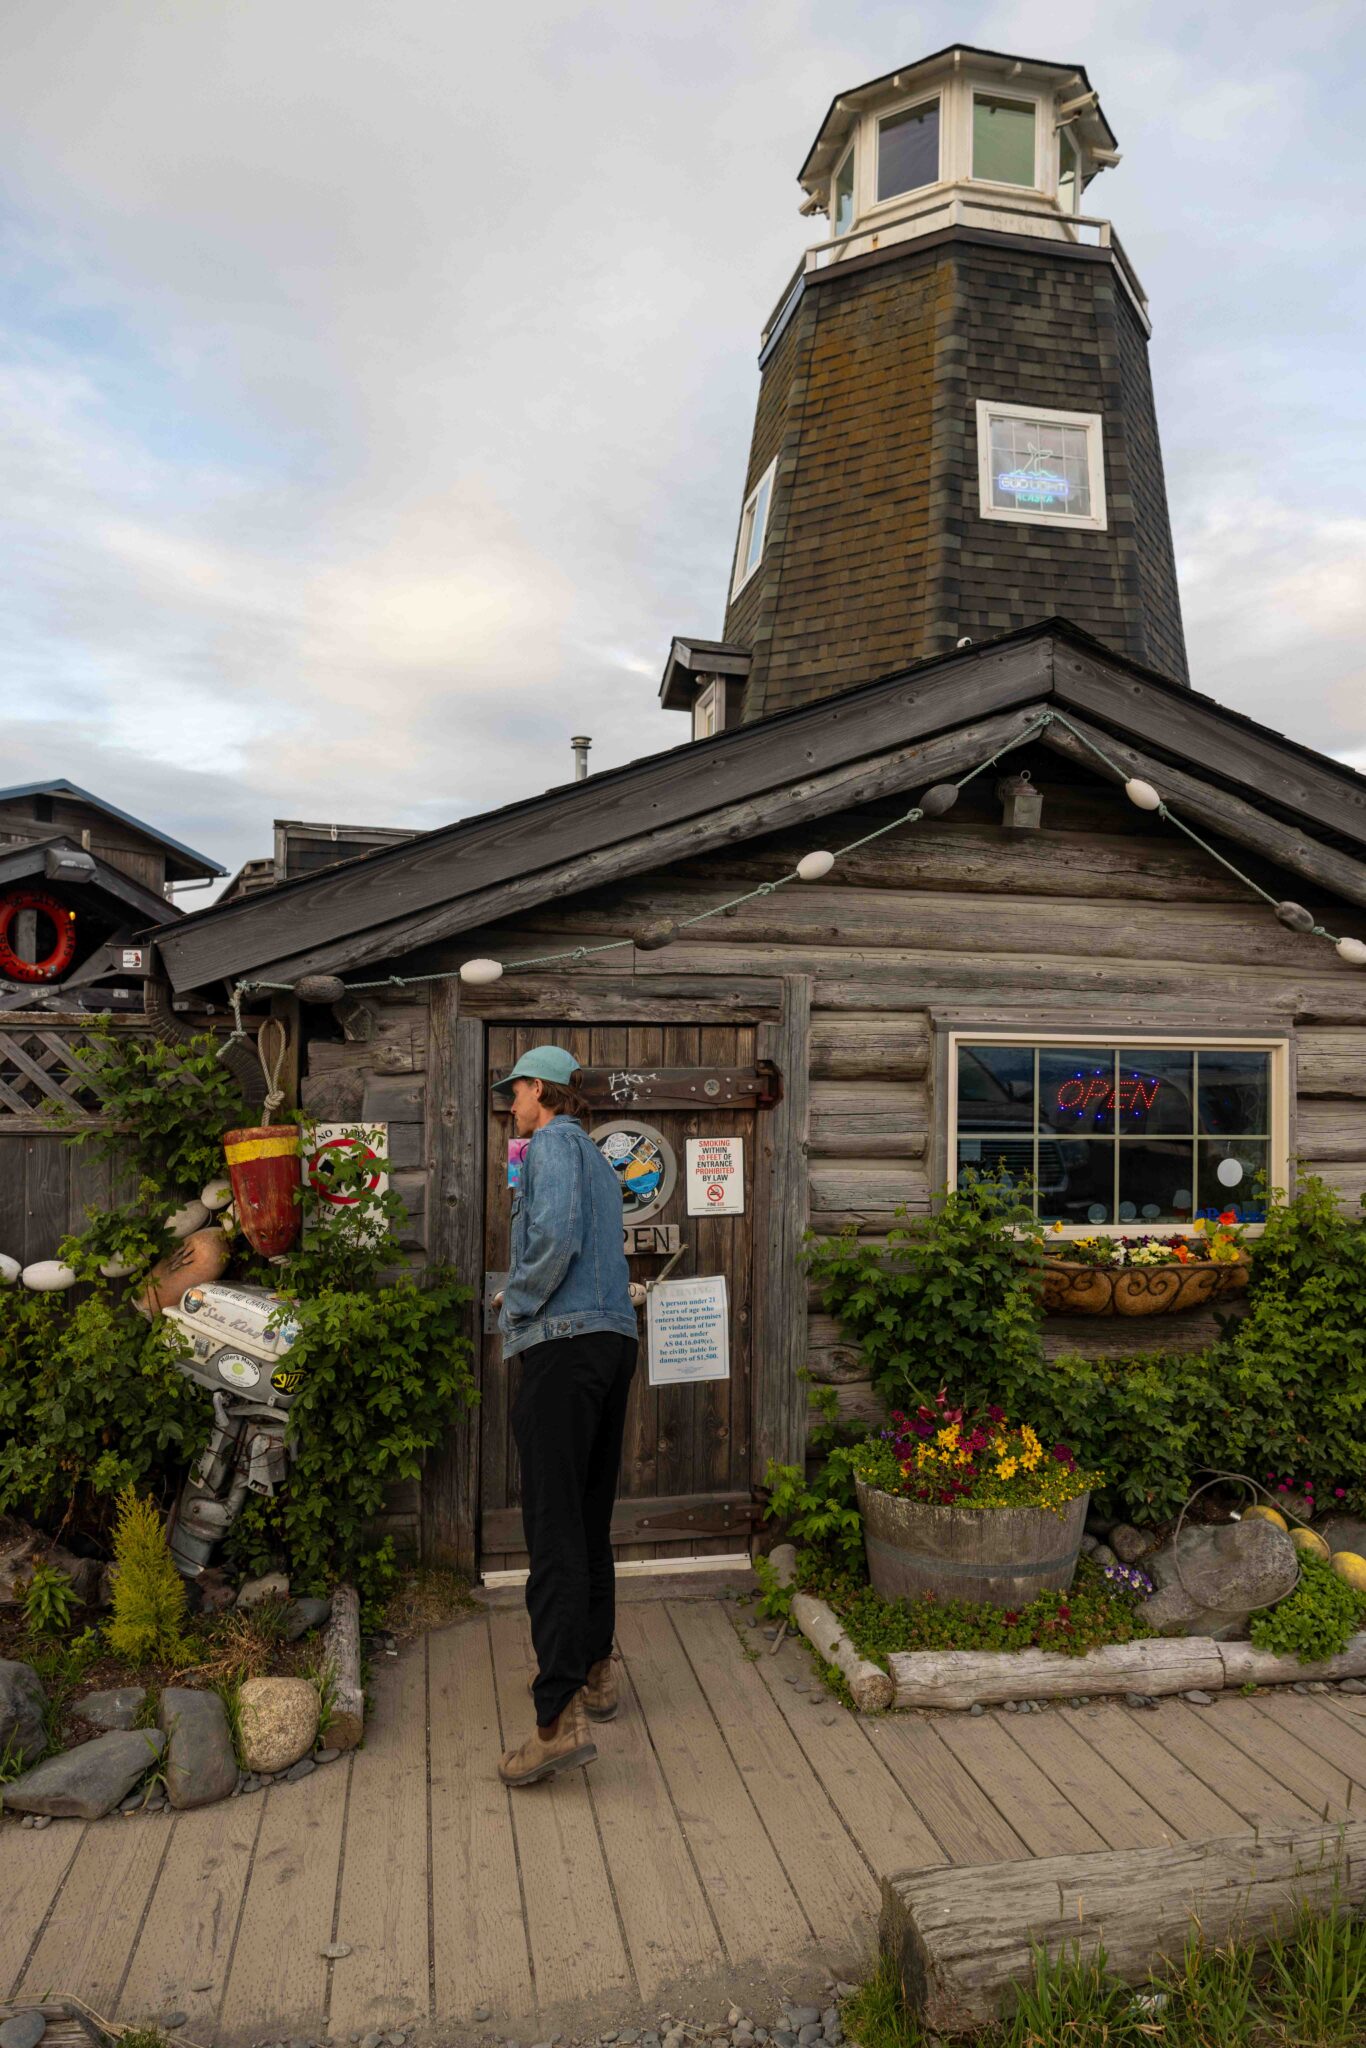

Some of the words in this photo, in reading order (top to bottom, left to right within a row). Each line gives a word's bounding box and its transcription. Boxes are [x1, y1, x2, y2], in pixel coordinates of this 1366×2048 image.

[1057, 1080, 1160, 1110] OPEN
[317, 1129, 333, 1142] NO
[698, 1139, 731, 1148] SMOKING
[701, 1146, 728, 1154] WITHIN
[706, 1153, 722, 1161] FEET
[697, 1160, 733, 1168] ENTRANCE
[695, 1167, 735, 1175] PROHIBITED
[713, 1174, 729, 1182] LAW
[665, 1300, 688, 1308] person
[662, 1308, 679, 1316] years
[689, 1307, 700, 1315] age
[701, 1305, 715, 1313] who
[655, 1316, 675, 1324] enters
[694, 1313, 722, 1322] premises
[668, 1323, 697, 1331] violation
[690, 1330, 708, 1338] under
[669, 1347, 688, 1355] civilly
[689, 1346, 707, 1354] liable
[659, 1357, 688, 1365] damages
[240, 1356, 259, 1376] Marina
